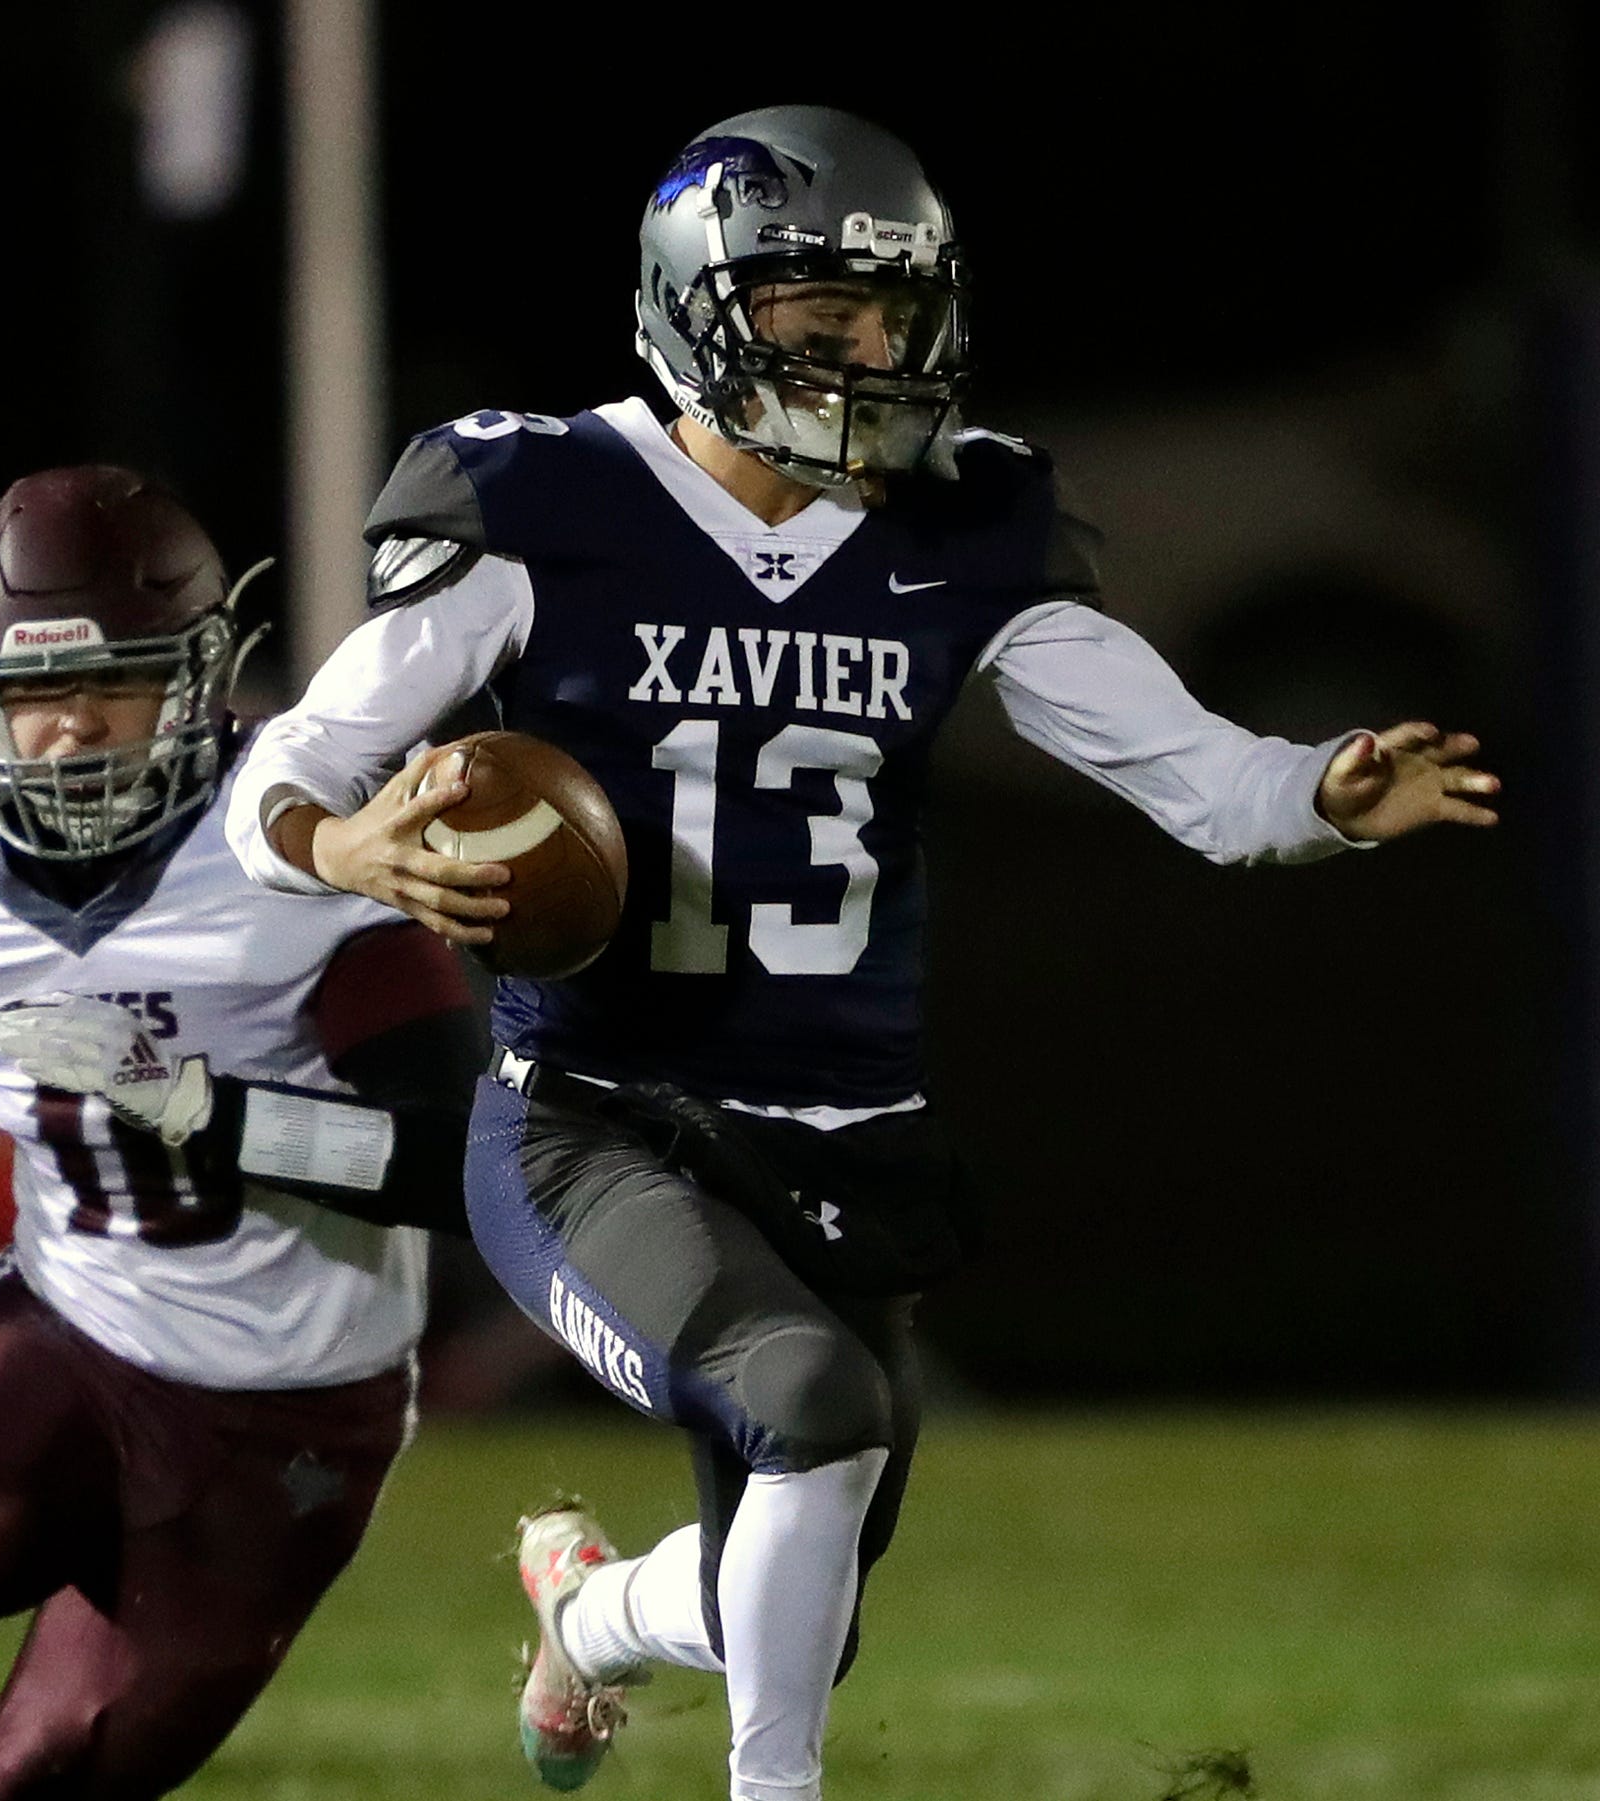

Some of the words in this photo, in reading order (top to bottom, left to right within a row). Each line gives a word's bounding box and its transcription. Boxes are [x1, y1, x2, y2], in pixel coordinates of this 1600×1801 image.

[672, 389, 715, 428] schutt
[14, 624, 90, 645] Riddell
[628, 623, 913, 720] XAVIER
[650, 719, 885, 975] 13
[113, 1065, 170, 1086] adidas
[550, 1270, 652, 1408] HAWKS
